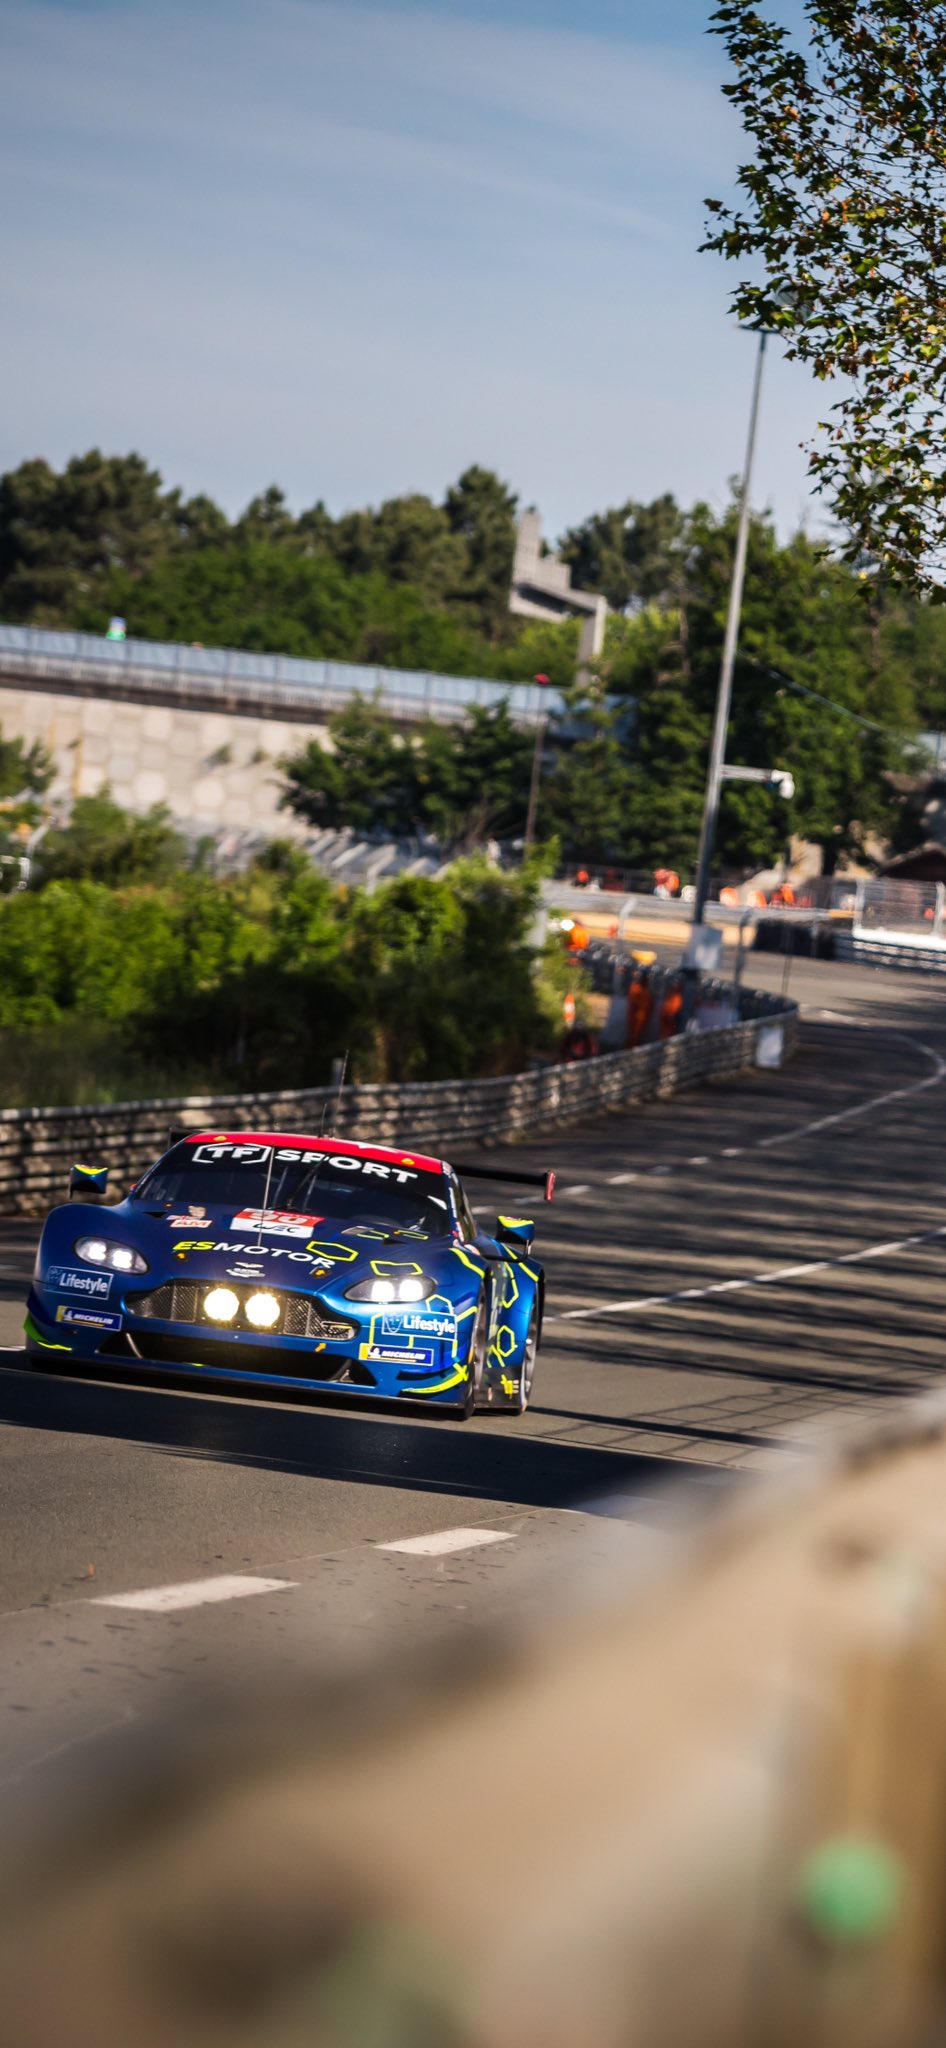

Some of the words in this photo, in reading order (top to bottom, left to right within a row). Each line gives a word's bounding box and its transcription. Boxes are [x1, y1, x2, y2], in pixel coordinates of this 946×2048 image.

[206, 1146, 261, 1159] TF
[274, 1149, 418, 1183] SPORT
[172, 1240, 336, 1269] ESMOTOR
[59, 1272, 108, 1294] Lifestyle
[73, 1313, 114, 1325] MICHELIN
[403, 1314, 456, 1336] Lifestyle
[381, 1350, 427, 1360] MICHELIN
